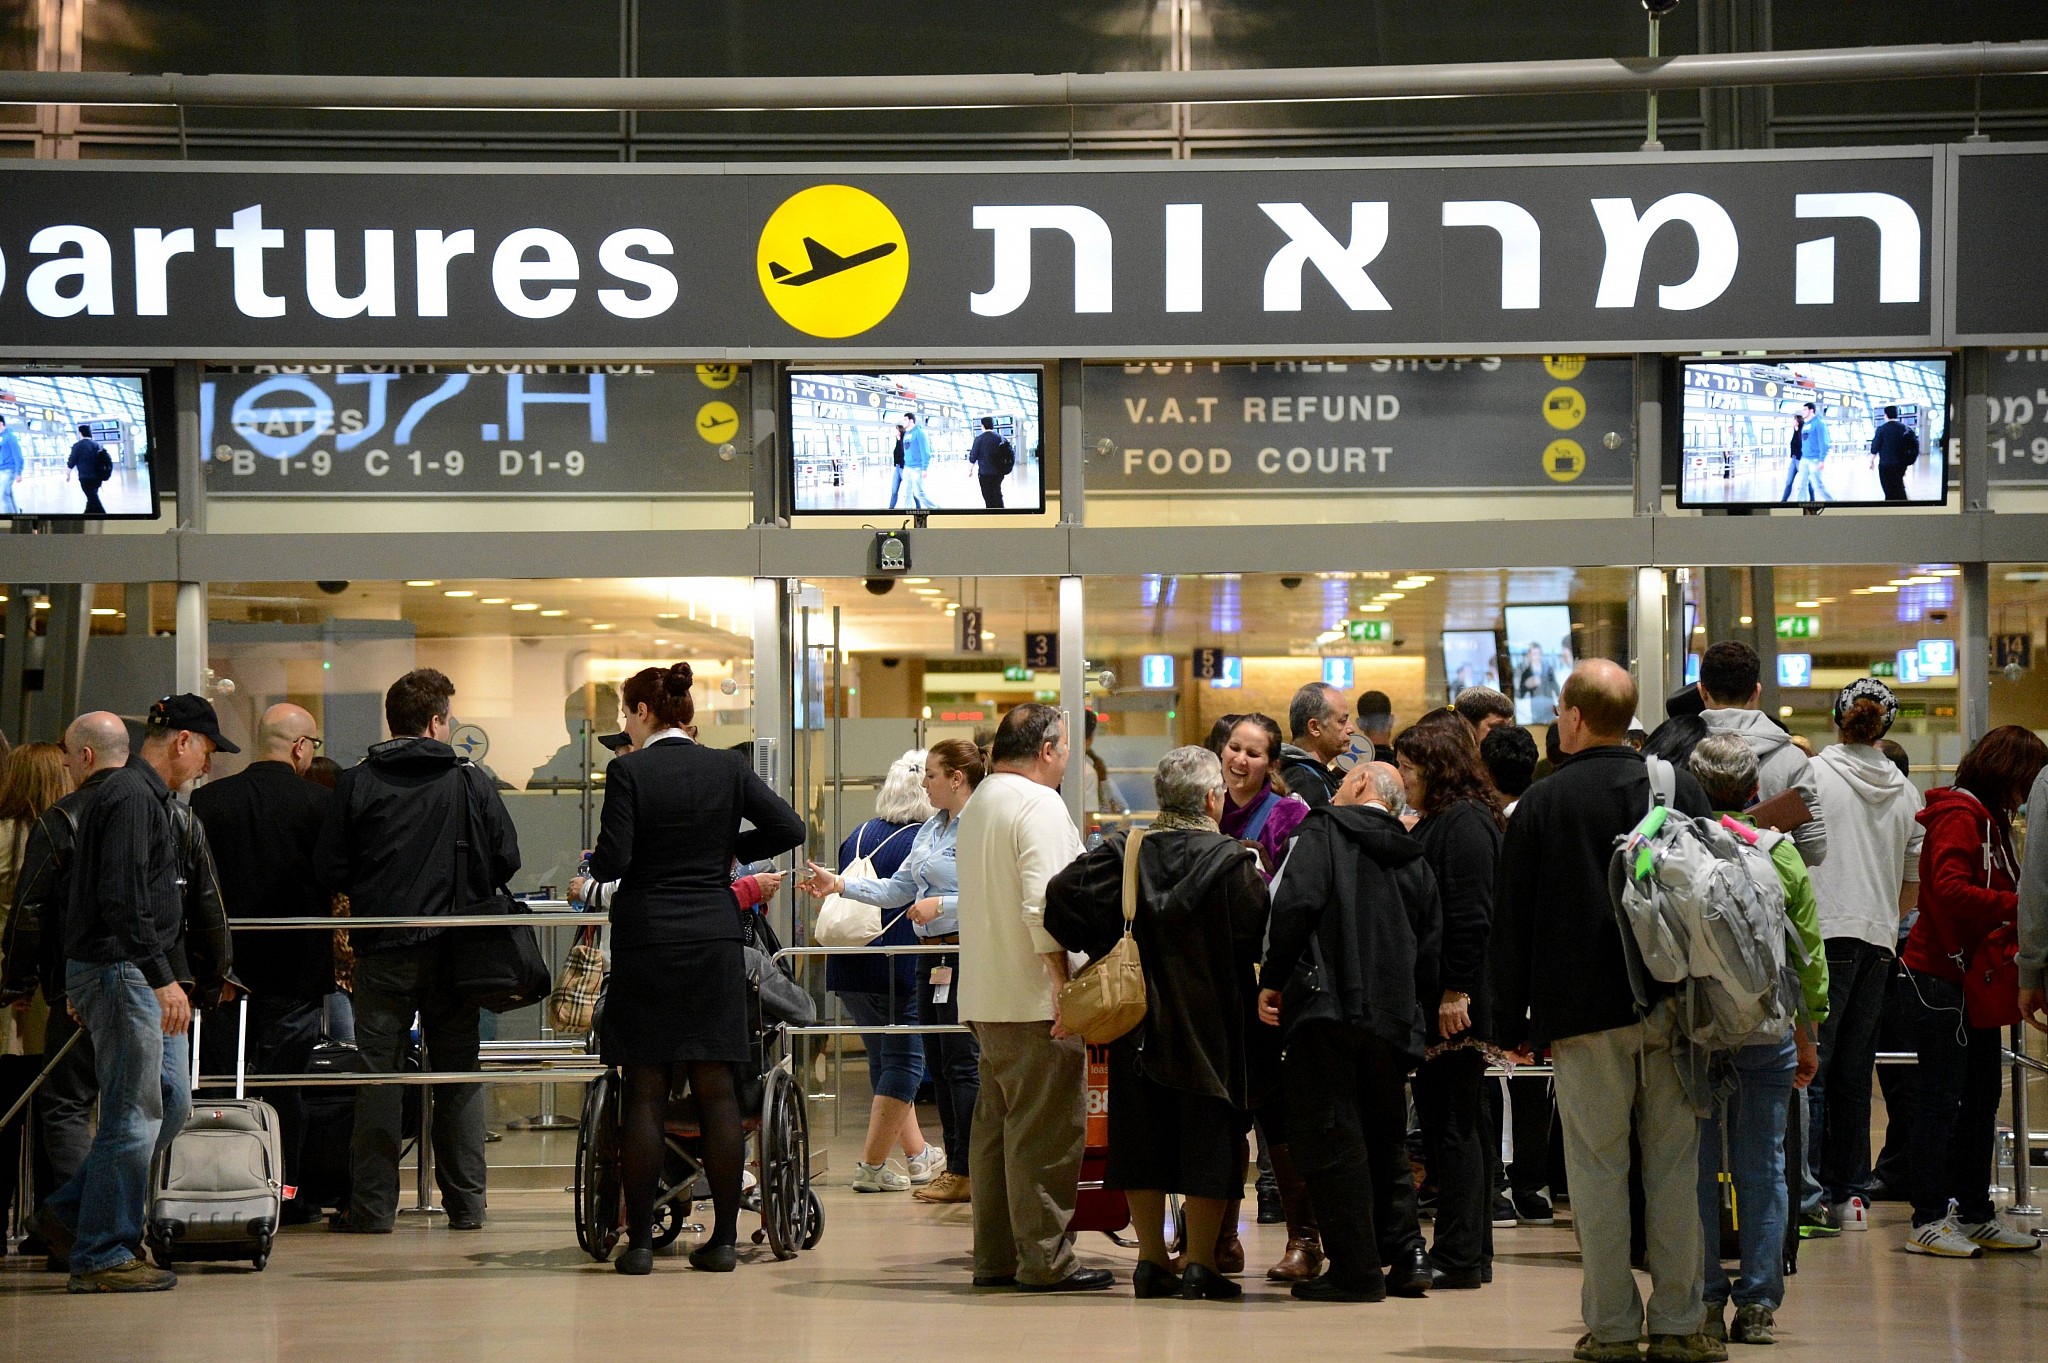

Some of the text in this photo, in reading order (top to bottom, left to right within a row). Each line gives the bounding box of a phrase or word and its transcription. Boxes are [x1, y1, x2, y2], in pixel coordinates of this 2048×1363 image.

[0, 203, 680, 319] artures
[969, 192, 1922, 318] המראות
[790, 380, 858, 403] המראו
[1684, 370, 1754, 394] המראו
[233, 409, 364, 436] GATES
[1125, 395, 1400, 424] V.A.T REFUND
[232, 450, 256, 476] B
[276, 450, 332, 477] 1-9
[364, 449, 390, 477] C
[407, 450, 465, 476] 1-9
[1124, 447, 1394, 475] FOOD COURT
[1091, 1064, 1108, 1074] leas
